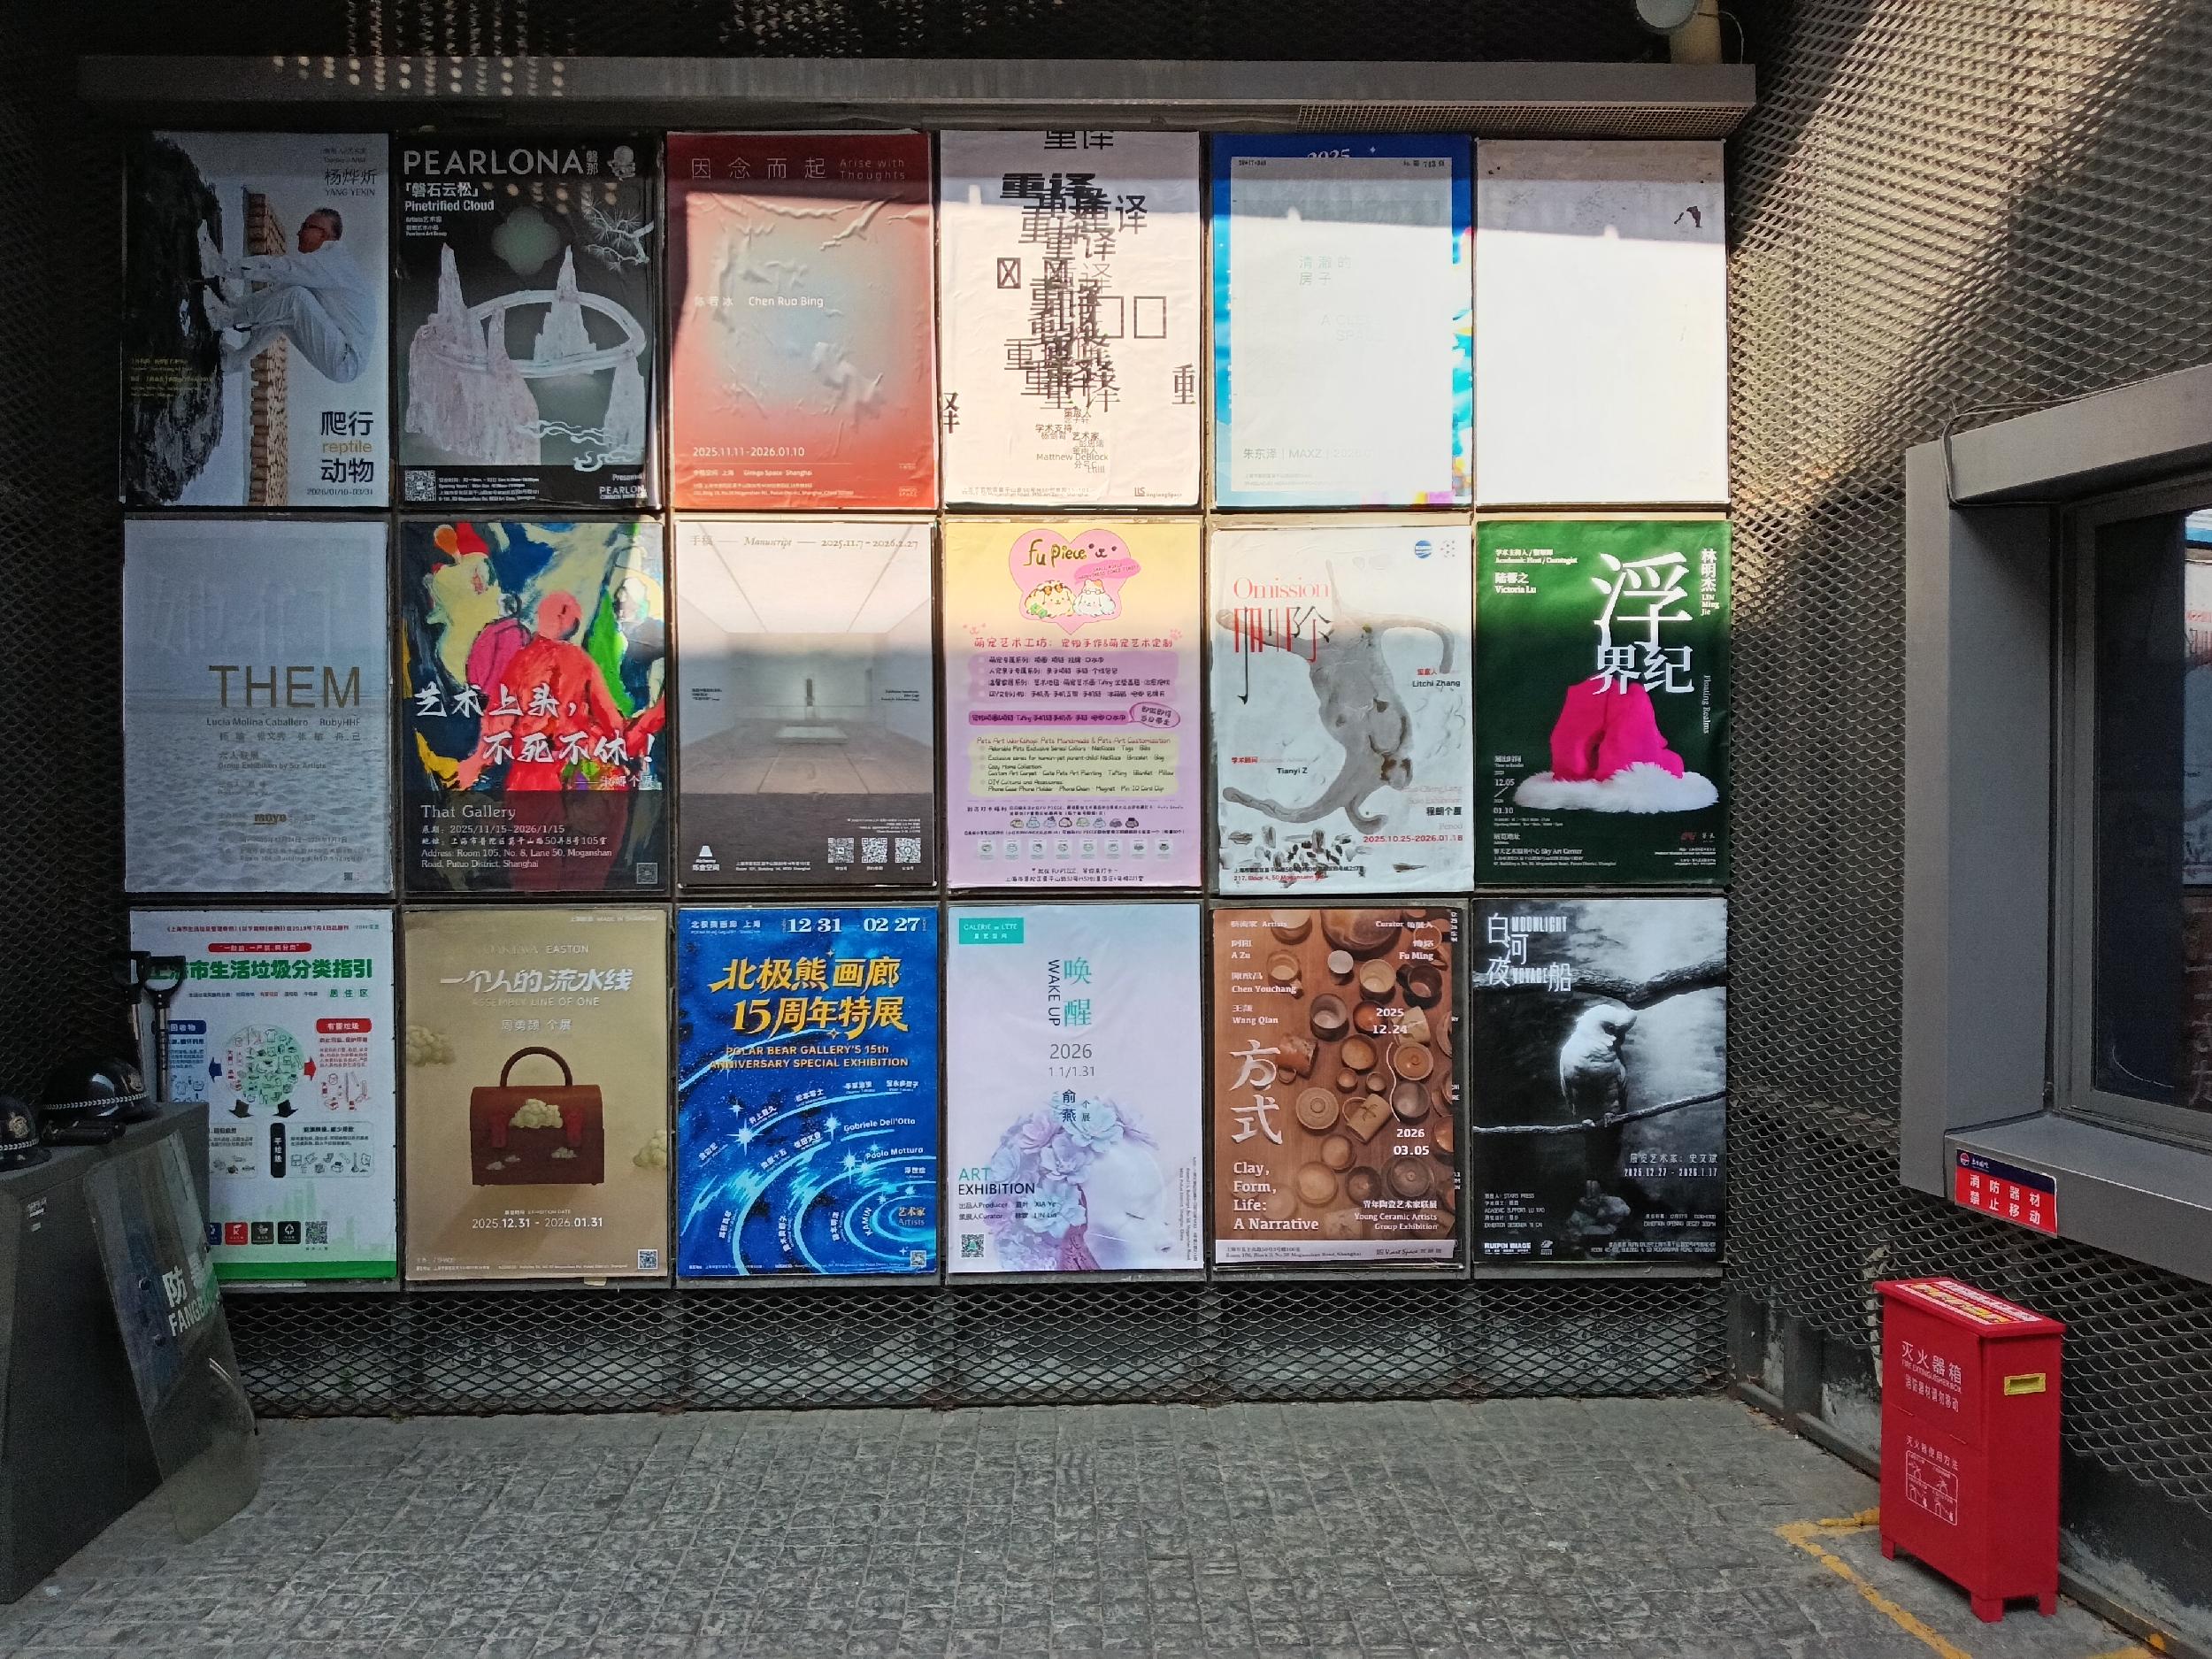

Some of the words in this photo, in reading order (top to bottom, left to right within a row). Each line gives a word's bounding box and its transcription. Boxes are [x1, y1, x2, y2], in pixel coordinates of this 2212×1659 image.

[403, 148, 585, 175] PEARLONA
[691, 157, 827, 179] 因念而起
[838, 158, 872, 168] Arise
[878, 158, 905, 168] with
[838, 171, 906, 180] Thoughts
[405, 200, 460, 213] Pinetrified
[465, 200, 495, 213] Cloud
[749, 296, 776, 306] Chen
[779, 296, 799, 306] Ruo
[802, 296, 825, 309] Bing
[320, 411, 374, 436] 爬行
[322, 441, 373, 456] reptile
[693, 446, 806, 457] 2025.11.11-2026.01.10
[320, 457, 374, 484] 动物
[1233, 577, 1330, 601] Omission
[1589, 645, 1696, 696] 界纪
[207, 665, 360, 709] THEM
[1411, 680, 1434, 689] Litchi
[1436, 680, 1462, 692] Zhang
[206, 718, 231, 726] Lucia
[233, 718, 264, 726] Molina
[265, 718, 309, 726] Caballero
[1276, 765, 1301, 778] Tianyi
[1302, 766, 1309, 776] Z
[1494, 779, 1515, 787] 12.05
[420, 804, 457, 819] That
[462, 804, 517, 821] Gallery
[1494, 806, 1515, 815] 01.10
[567, 849, 612, 859] Moganshan
[503, 860, 540, 870] Shanghai
[818, 918, 842, 933] 31
[863, 917, 888, 933] 02
[896, 917, 920, 932] 27
[1511, 917, 1568, 933] MOONLIGHT
[546, 944, 590, 955] EASTON
[1398, 952, 1409, 961] Fu
[1410, 951, 1434, 962] Ming
[150, 958, 373, 979] 市生活垃圾分类指引
[440, 969, 635, 994] 一个人的流水线
[708, 956, 902, 995] 北极熊画廊
[1048, 958, 1061, 1002] WAKE
[328, 987, 369, 998] 居住区
[1063, 956, 1093, 1027] 唤醒
[1231, 985, 1253, 994] Chen
[1254, 985, 1297, 995] Youchang
[472, 997, 529, 1007] ASSEMBLY
[531, 997, 556, 1007] LINE
[558, 997, 576, 1007] OF
[578, 997, 601, 1007] ONE
[731, 996, 910, 1041] 15周年特展
[1048, 1008, 1061, 1026] UP
[1376, 1008, 1405, 1017] 2025
[170, 1022, 196, 1032] 回收物
[546, 1019, 573, 1033] 个展
[1231, 1017, 1256, 1026] Wang
[1257, 1017, 1279, 1025] Qian
[1372, 1025, 1408, 1035] 12.24
[726, 1046, 764, 1056] POLAR
[767, 1046, 796, 1056] BEAR
[801, 1045, 863, 1056] GALLERY'S
[864, 1044, 889, 1055] 15th
[1048, 1043, 1094, 1060] 2026
[708, 1058, 790, 1070] ANNIVERSARY
[793, 1057, 841, 1069] SPECIAL
[843, 1056, 909, 1068] EXHIBITION
[1229, 1039, 1284, 1146] 方式
[843, 1121, 878, 1133] Gabriele
[879, 1117, 917, 1127] Dell'Otto
[1395, 1128, 1425, 1139] 2026
[865, 1149, 889, 1160] Paolo
[890, 1147, 925, 1156] Mottura
[1393, 1145, 1430, 1156] 03.05
[958, 1168, 993, 1182] ART
[1233, 1162, 1271, 1178] Clay,
[958, 1182, 1036, 1196] EXHIBITION
[1233, 1180, 1277, 1194] Form,
[1970, 1172, 2041, 1209] 消防器材
[898, 1207, 926, 1217] 艺术家
[1233, 1199, 1268, 1212] Life:
[1970, 1189, 2042, 1225] 禁止移动
[898, 1217, 926, 1227] Artists
[1354, 1211, 1378, 1222] Young
[1379, 1211, 1410, 1220] Ceramic
[1411, 1211, 1438, 1220] Artists
[472, 1217, 531, 1230] 2025.12.31
[544, 1217, 603, 1228] 2026.01.31
[1233, 1218, 1246, 1230] A
[1248, 1217, 1319, 1230] Narrative
[1373, 1222, 1398, 1232] Group
[1399, 1221, 1438, 1230] Exhibition
[1901, 1340, 1962, 1386] 灭火器箱
